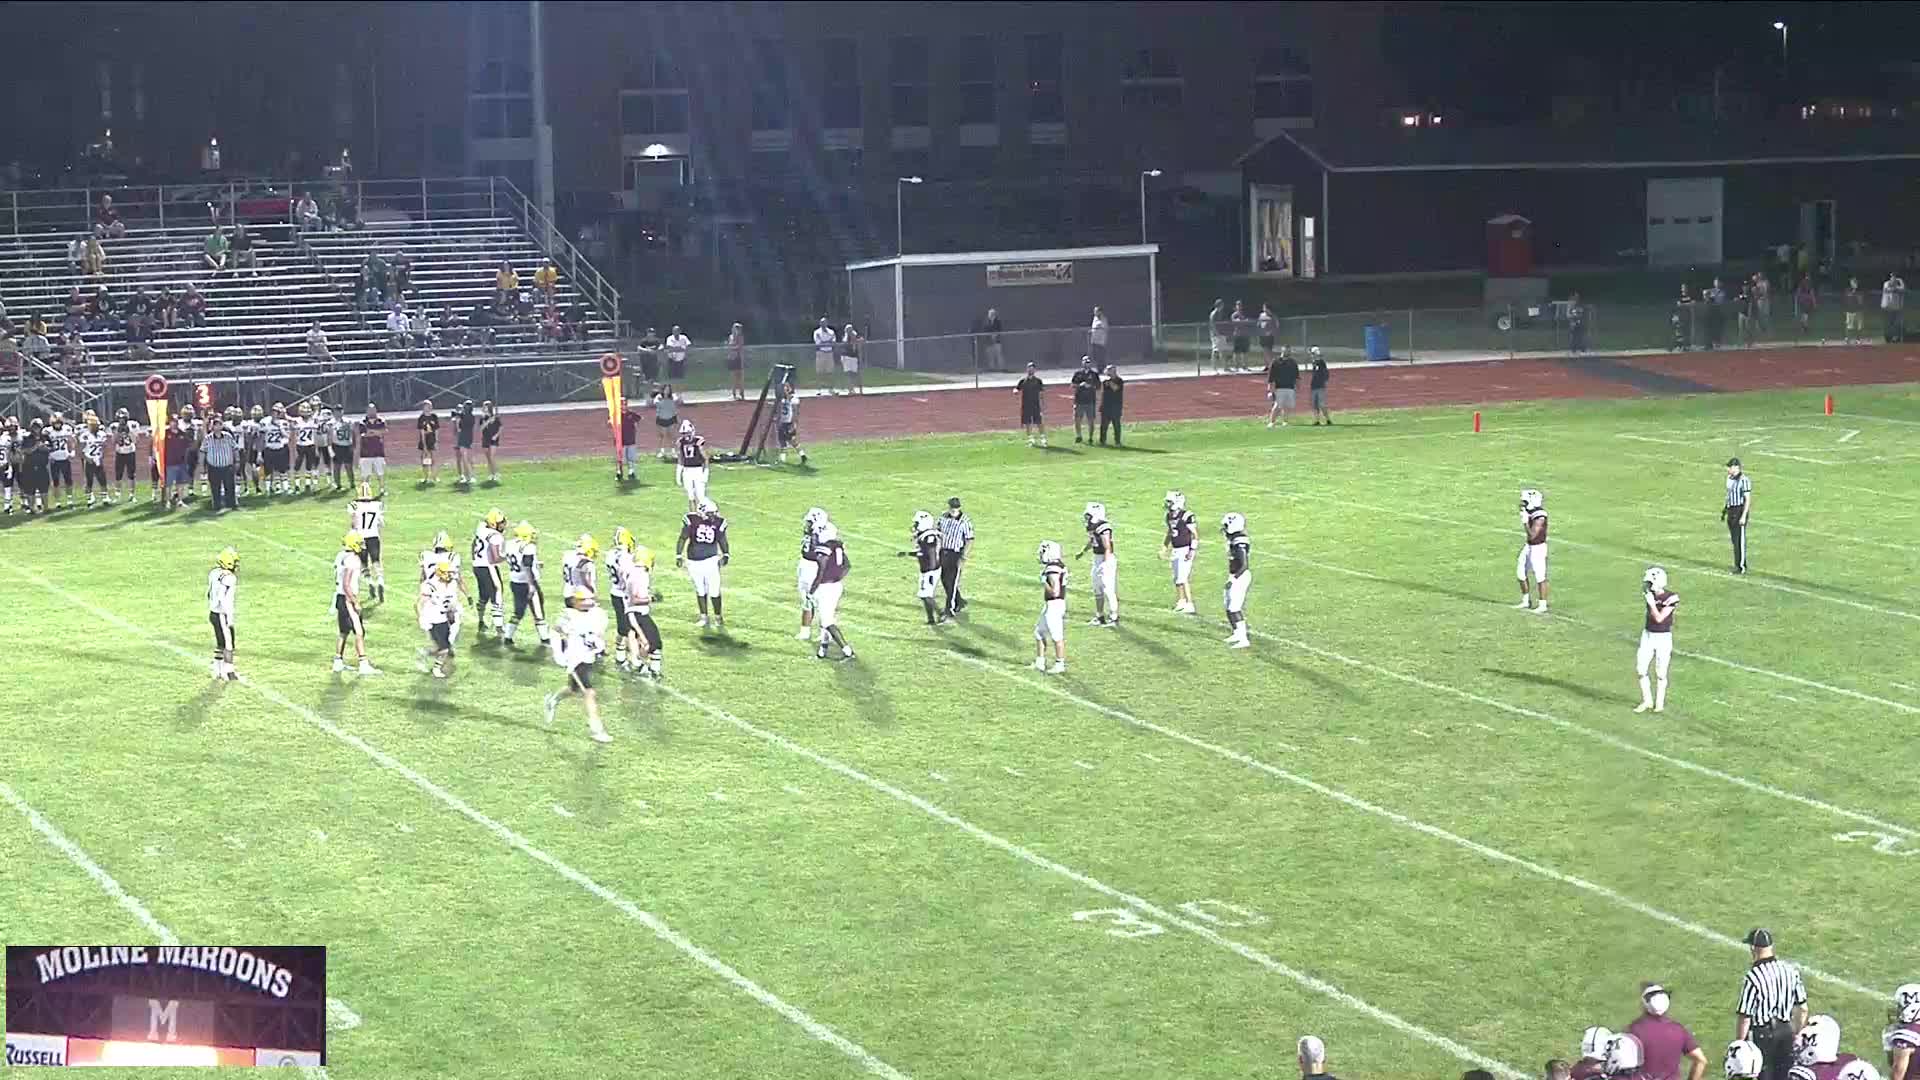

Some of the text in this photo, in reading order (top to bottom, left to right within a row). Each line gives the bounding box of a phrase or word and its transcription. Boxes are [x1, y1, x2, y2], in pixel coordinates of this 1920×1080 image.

[196, 384, 209, 404] 3
[267, 431, 281, 443] 22
[361, 511, 377, 530] 17
[696, 528, 716, 544] 59
[1901, 991, 1919, 1004] M
[1801, 1033, 1818, 1047] M
